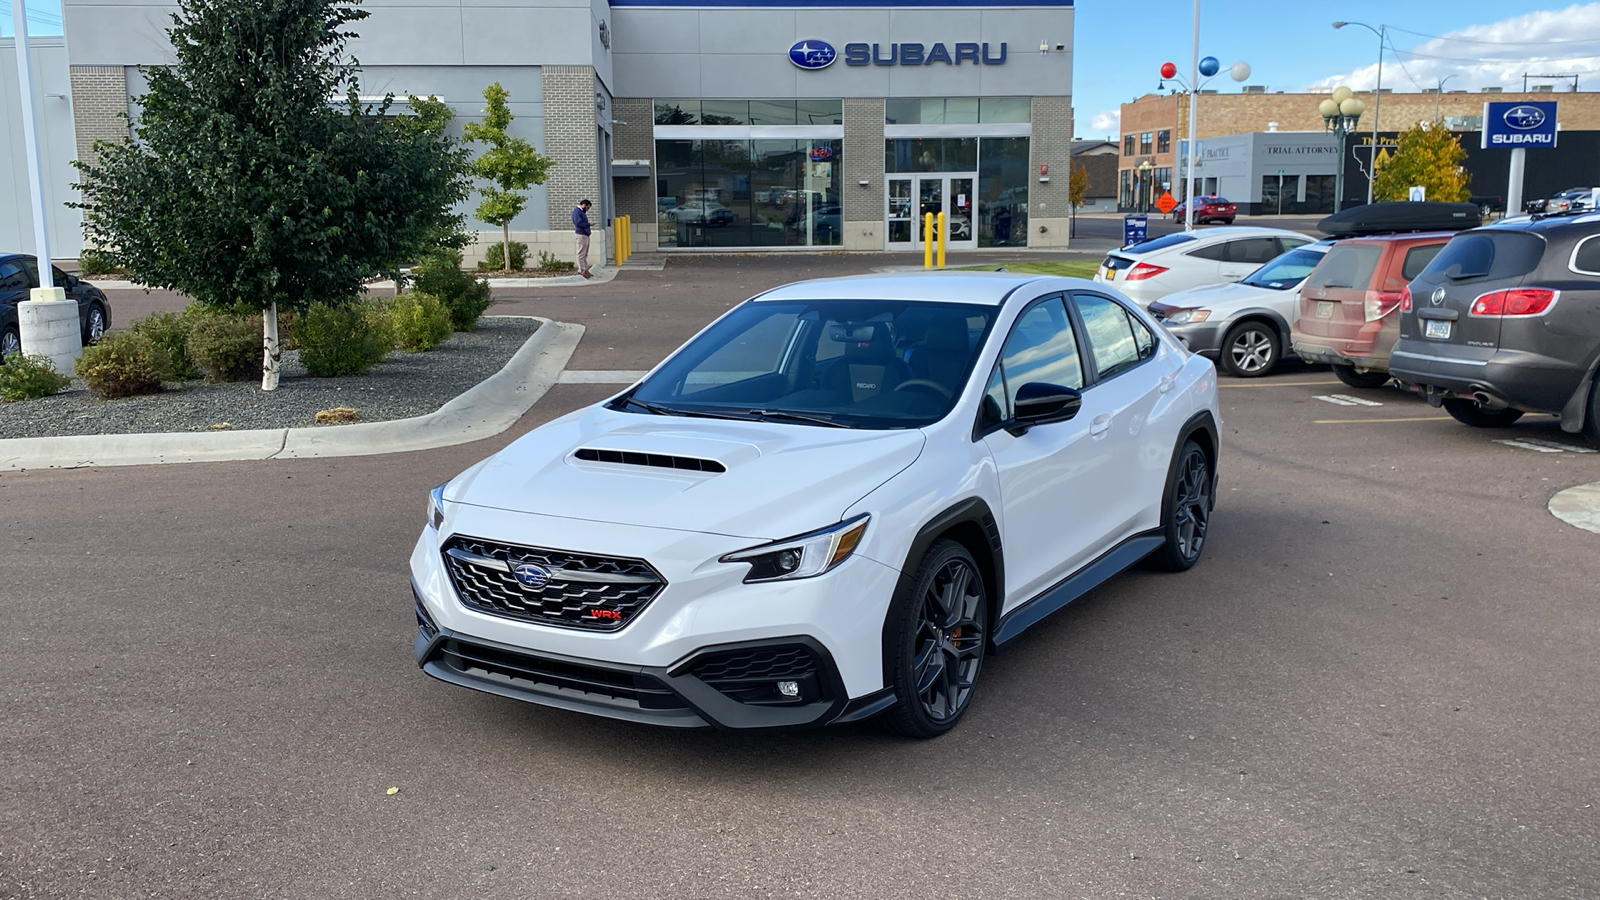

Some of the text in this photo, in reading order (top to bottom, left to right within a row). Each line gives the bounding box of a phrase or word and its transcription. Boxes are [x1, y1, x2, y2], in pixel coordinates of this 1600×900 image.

[844, 42, 1007, 66] SUBARU
[1362, 136, 1400, 145] Th Prac
[1492, 133, 1552, 143] SUBARU
[809, 148, 830, 158] OPEN
[590, 609, 621, 619] WRX
